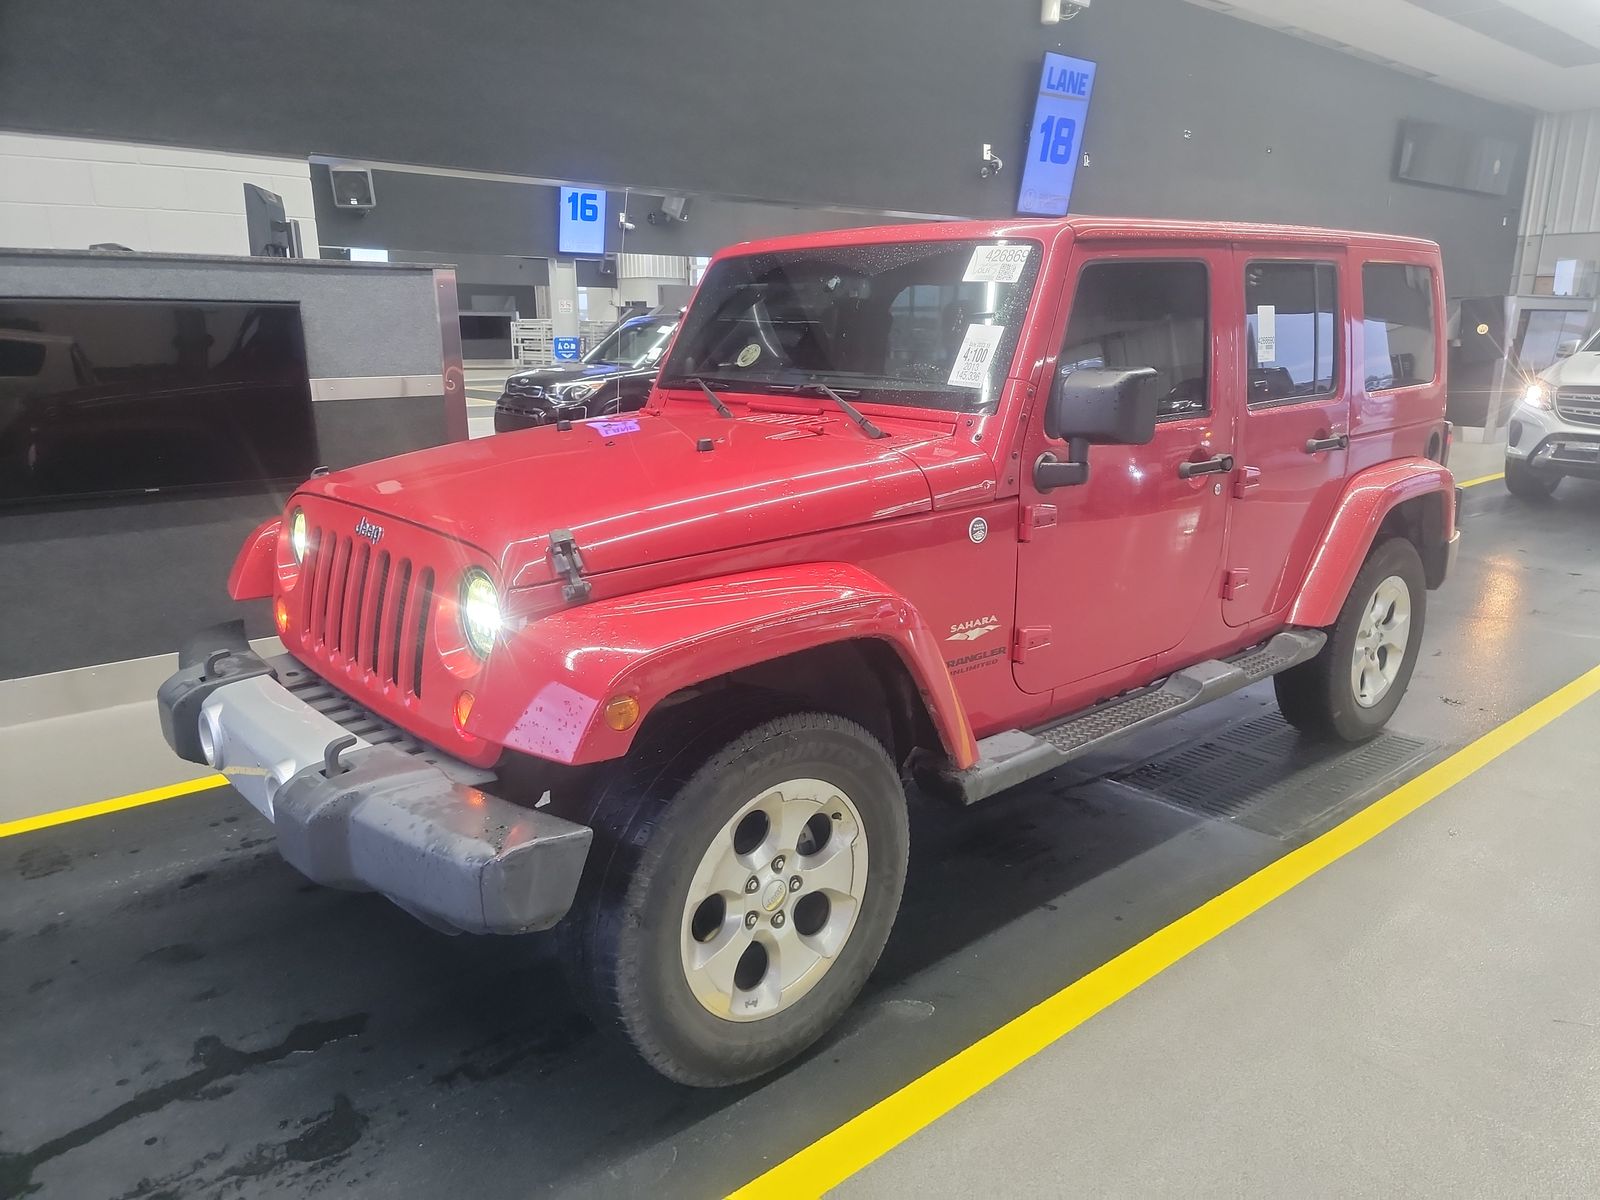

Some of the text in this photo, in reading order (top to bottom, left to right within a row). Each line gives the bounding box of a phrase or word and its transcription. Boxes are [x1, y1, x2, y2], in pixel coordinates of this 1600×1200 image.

[1046, 66, 1089, 96] LANE
[1040, 115, 1076, 165] 18
[568, 192, 598, 222] 16
[986, 249, 1030, 263] 426869
[963, 347, 988, 363] 4:100
[963, 362, 980, 371] 2013
[355, 516, 385, 545] Jeep
[950, 615, 998, 633] SAHARA
[945, 646, 1007, 668] RANGLER
